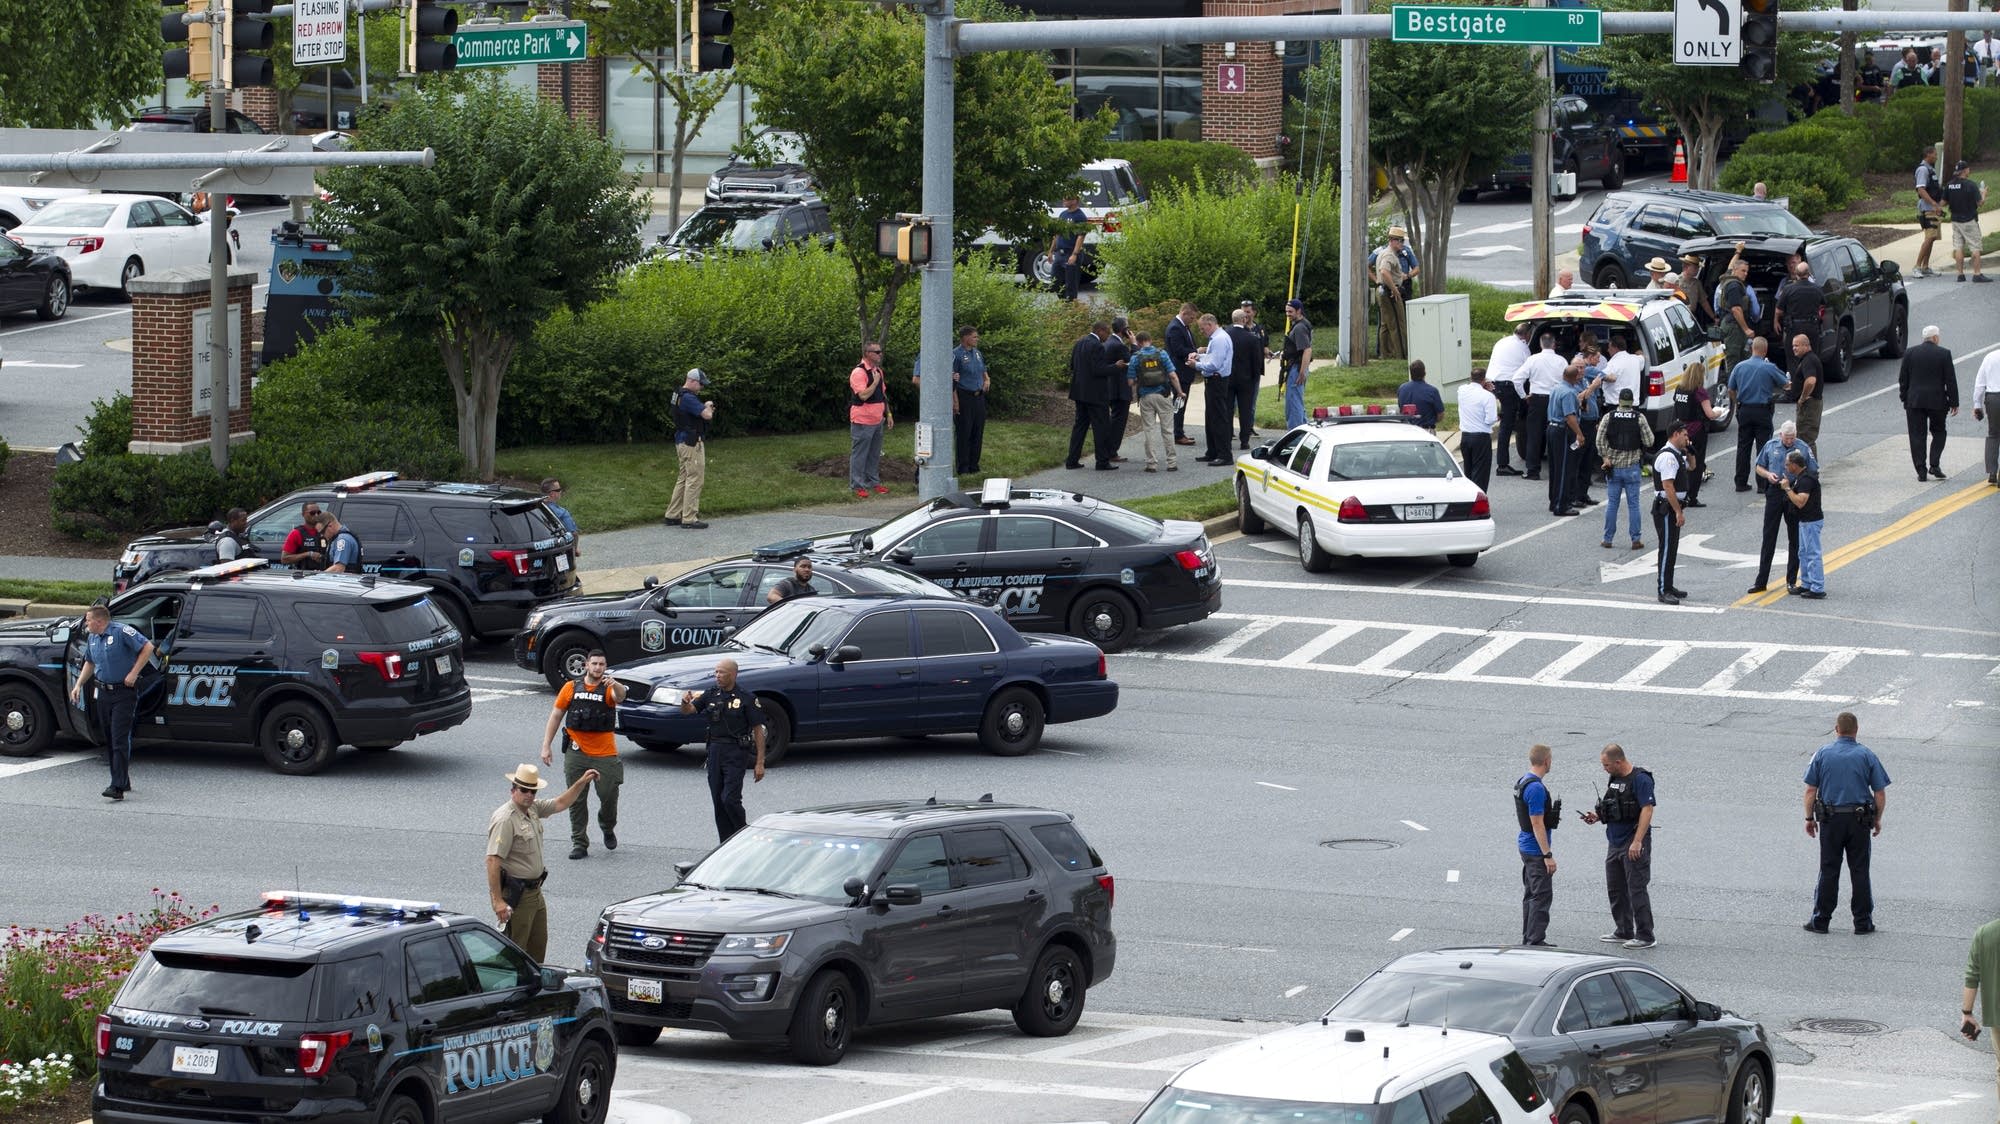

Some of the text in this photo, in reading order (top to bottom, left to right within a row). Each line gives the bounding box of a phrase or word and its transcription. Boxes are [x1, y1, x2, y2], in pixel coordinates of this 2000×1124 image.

[301, 1, 340, 16] FLASHING
[297, 21, 342, 37] RED ARROW
[1408, 11, 1584, 39] Bestgate RD
[296, 41, 343, 58] AFTER STOP
[456, 29, 565, 58] Commerce Park DR
[1683, 41, 1732, 57] ONLY
[1567, 73, 1610, 85] COUNT
[1572, 84, 1617, 96] POLICE
[303, 308, 326, 317] ANNE
[198, 351, 211, 364] THE
[1675, 393, 1689, 403] POLICE
[1614, 411, 1633, 419] POLICE
[956, 576, 1003, 588] ARUNDEL
[1004, 574, 1046, 586] COUNTY
[593, 609, 633, 618] ARUNDEL
[671, 627, 723, 646] COUNT
[408, 639, 434, 651] COUNTY
[192, 665, 238, 675] COUNTY
[574, 692, 604, 702] POLICE
[123, 1012, 176, 1028] COUNTY
[219, 1020, 283, 1037] POLICE
[443, 1021, 530, 1052] ANNE ARUNDEL COUNTY
[443, 1034, 537, 1095] POLICE
